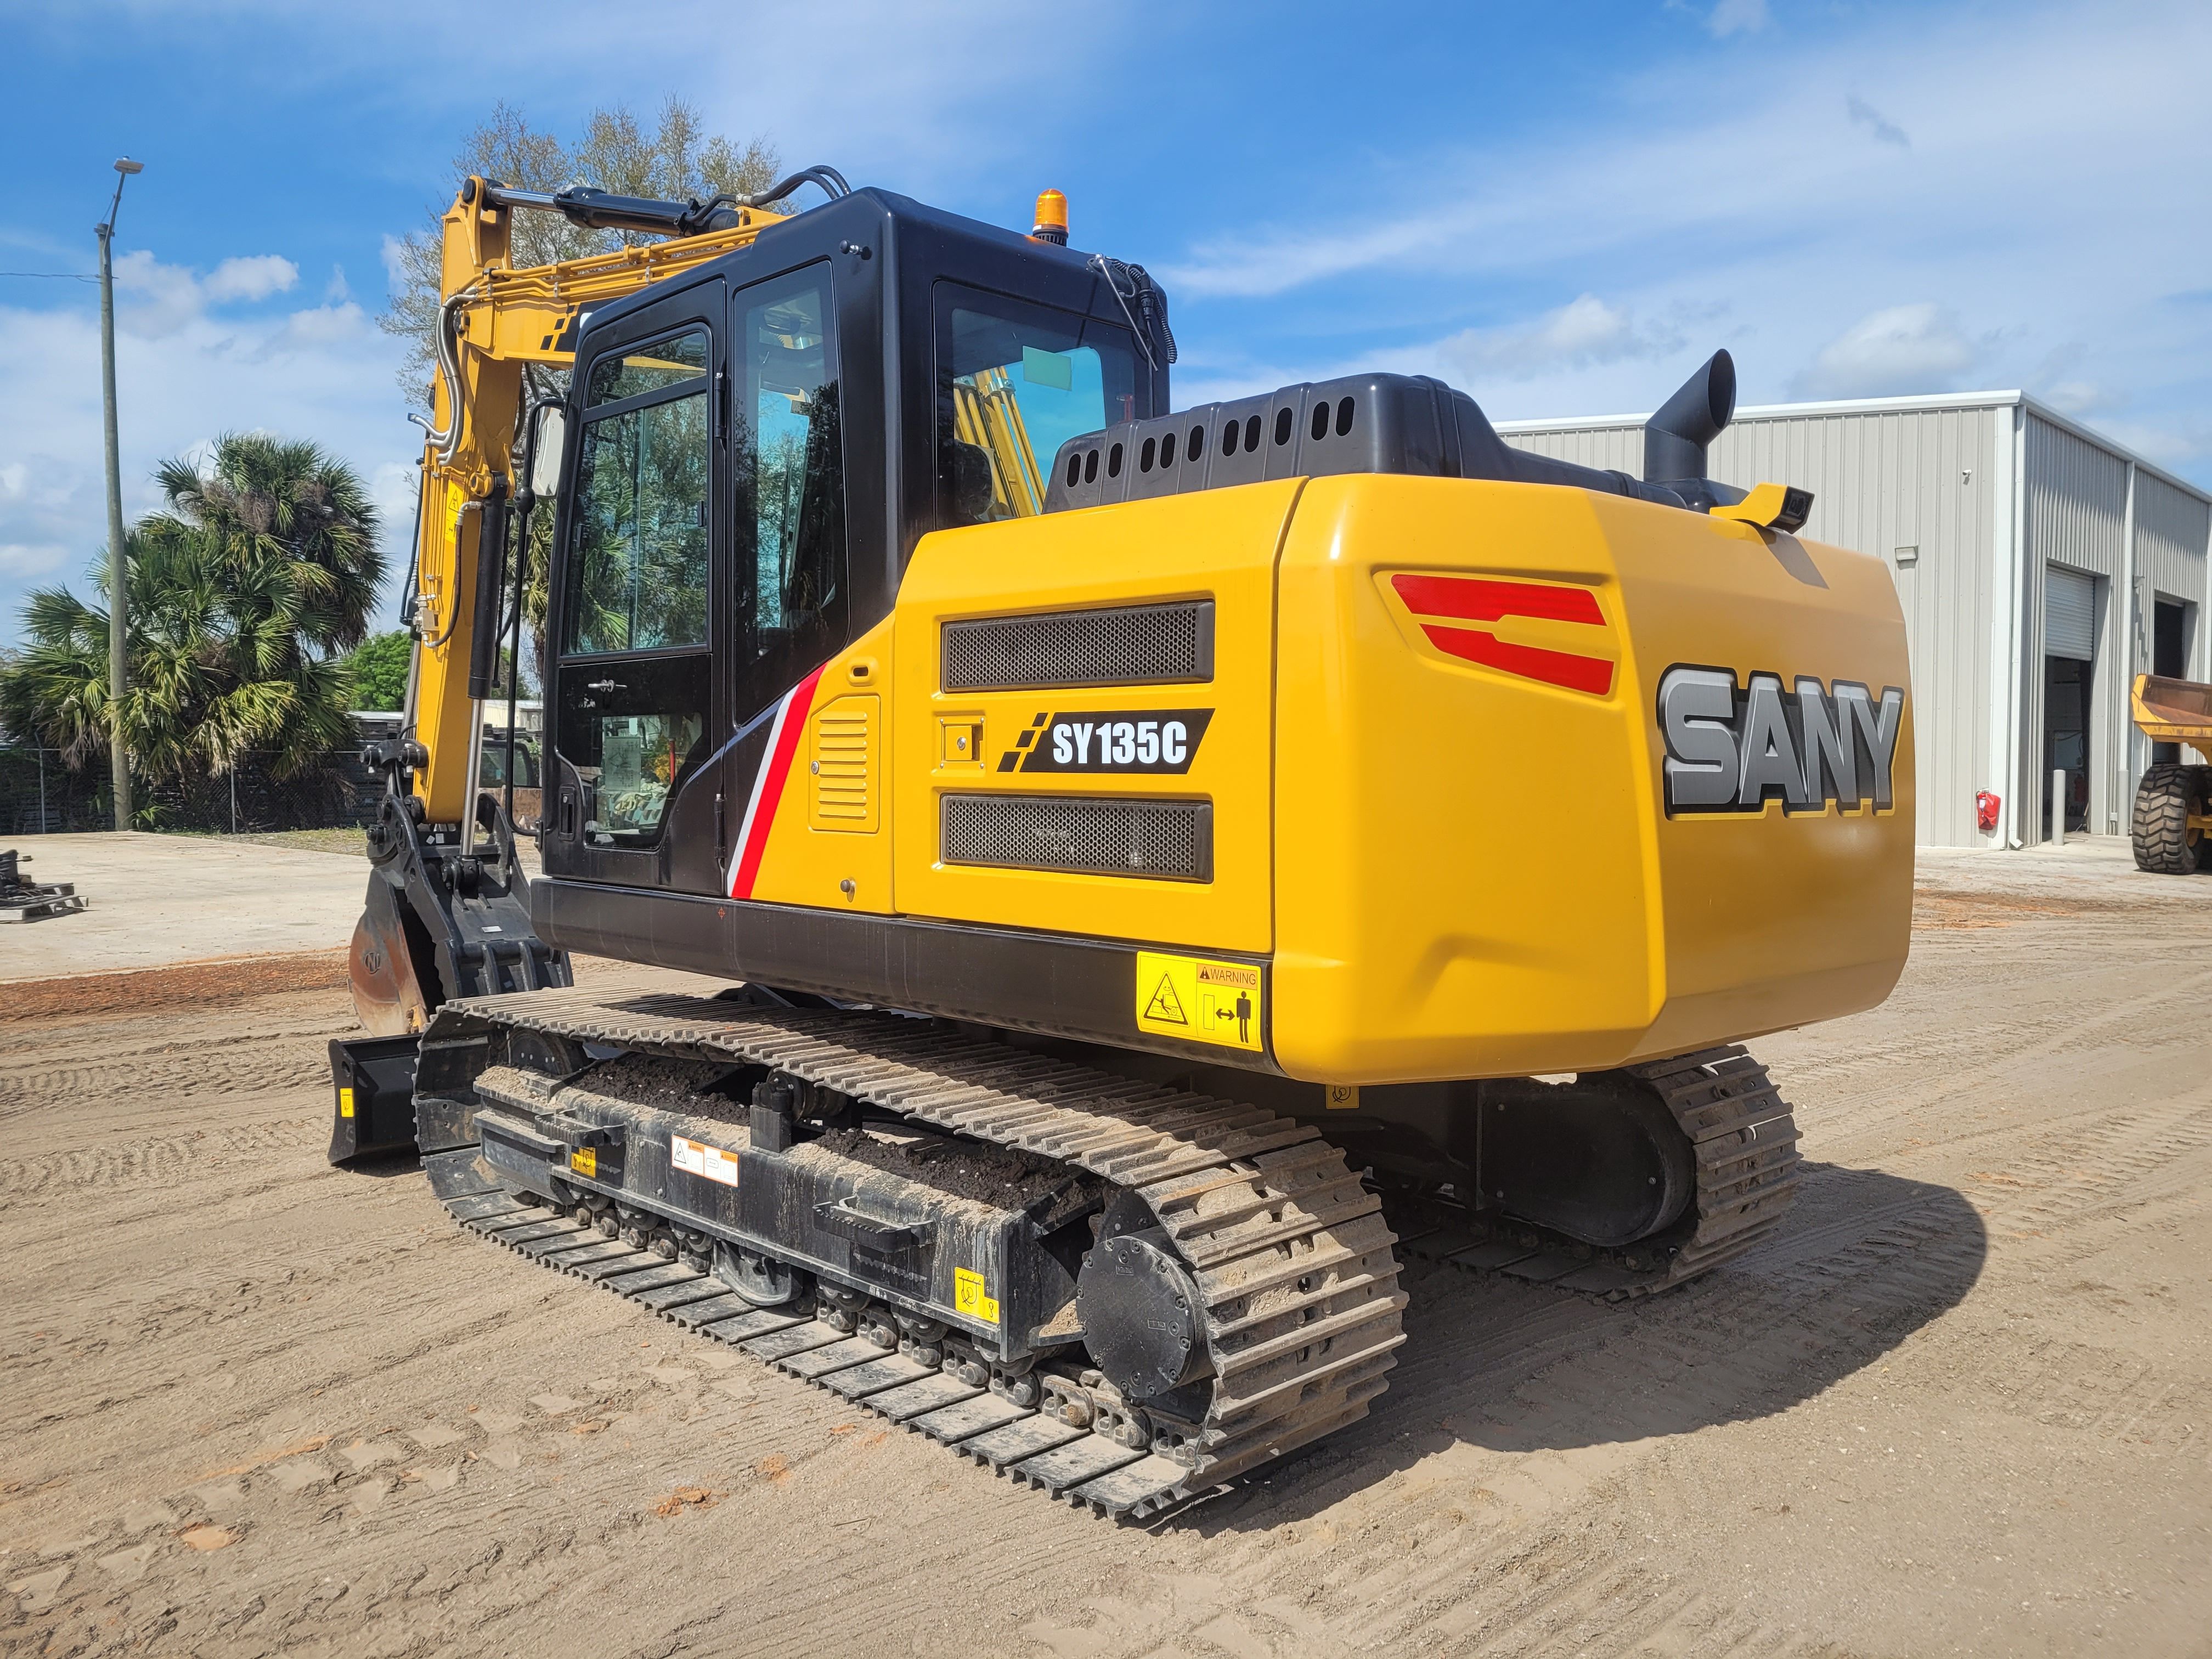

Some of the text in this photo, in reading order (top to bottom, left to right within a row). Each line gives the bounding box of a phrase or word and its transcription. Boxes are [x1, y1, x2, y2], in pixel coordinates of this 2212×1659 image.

[1052, 721, 1187, 764] SY135C
[1658, 665, 1903, 812] SANY
[1210, 968, 1256, 985] WARNING
